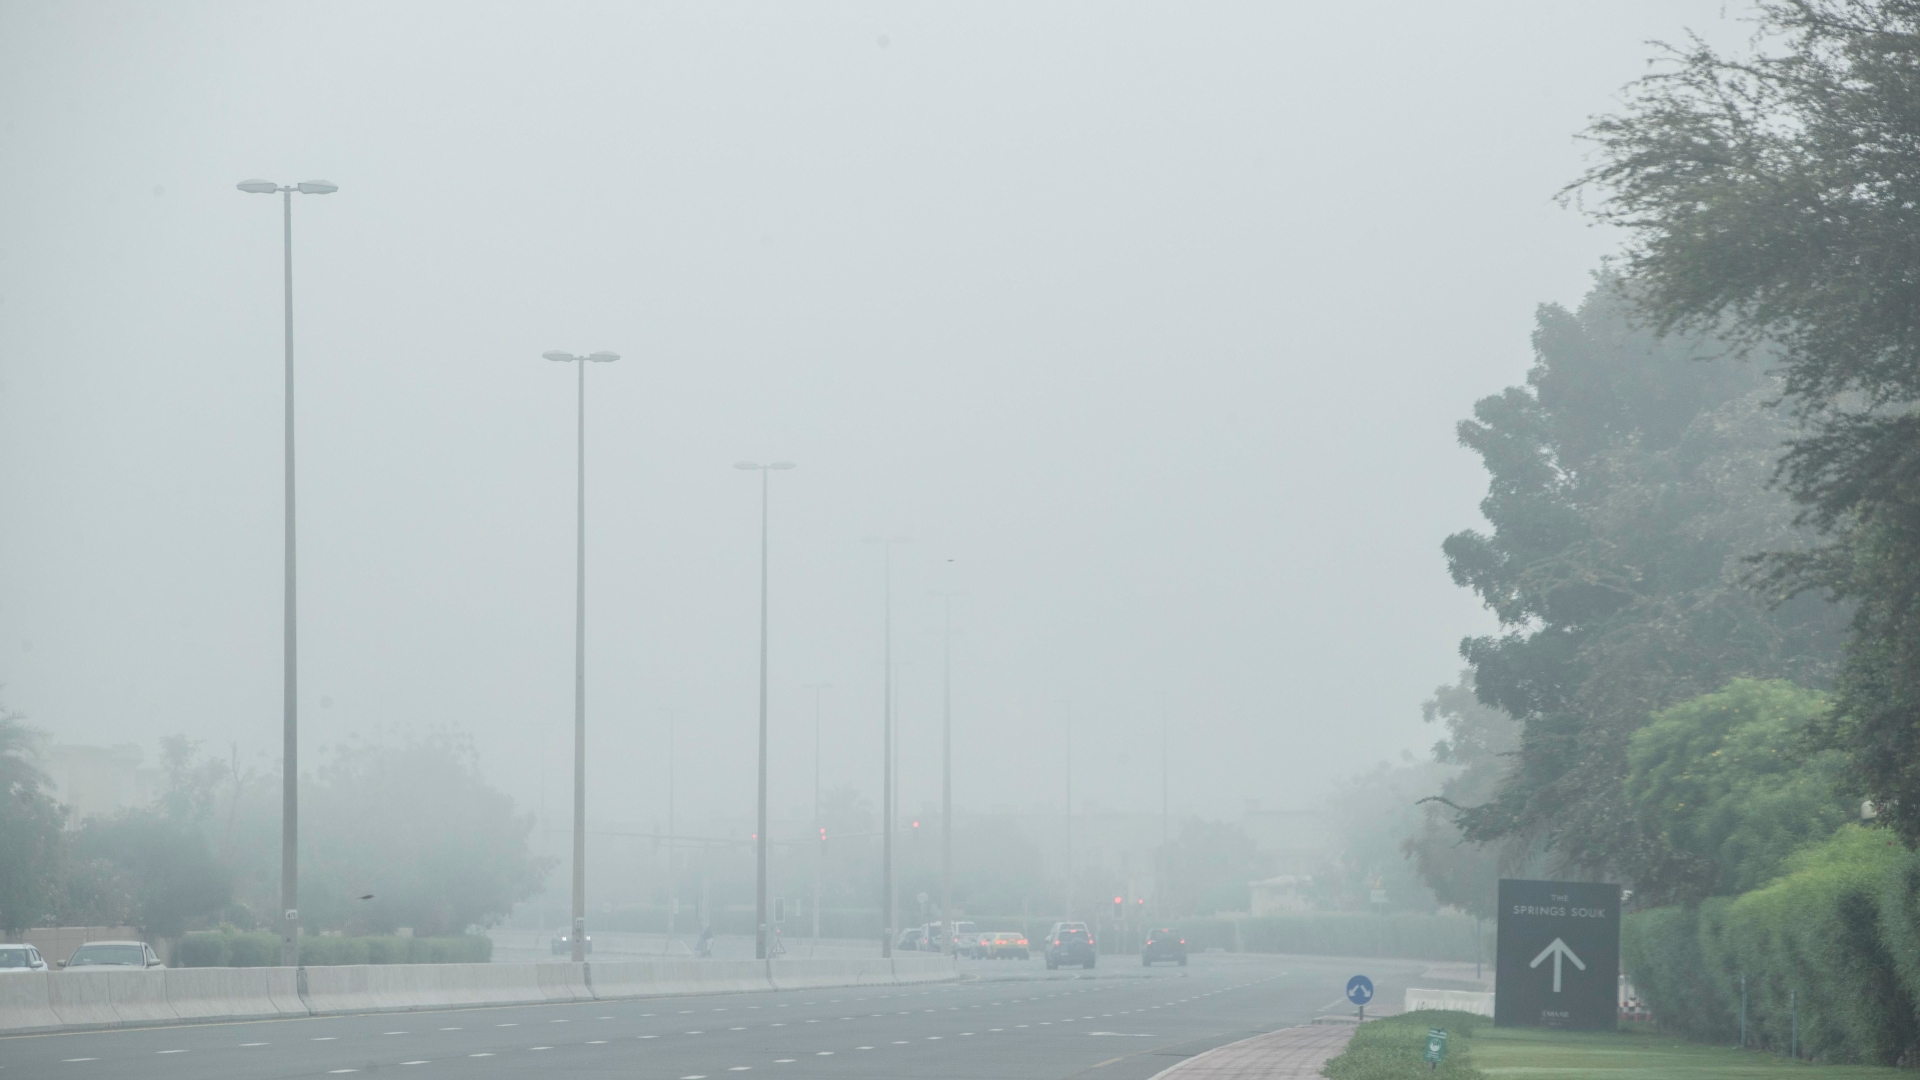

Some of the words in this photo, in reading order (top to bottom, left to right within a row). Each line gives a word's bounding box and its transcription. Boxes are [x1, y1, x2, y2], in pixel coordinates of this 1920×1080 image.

[1550, 894, 1569, 902] THE
[1512, 905, 1566, 917] SPRINGS
[1570, 907, 1605, 919] SOUK
